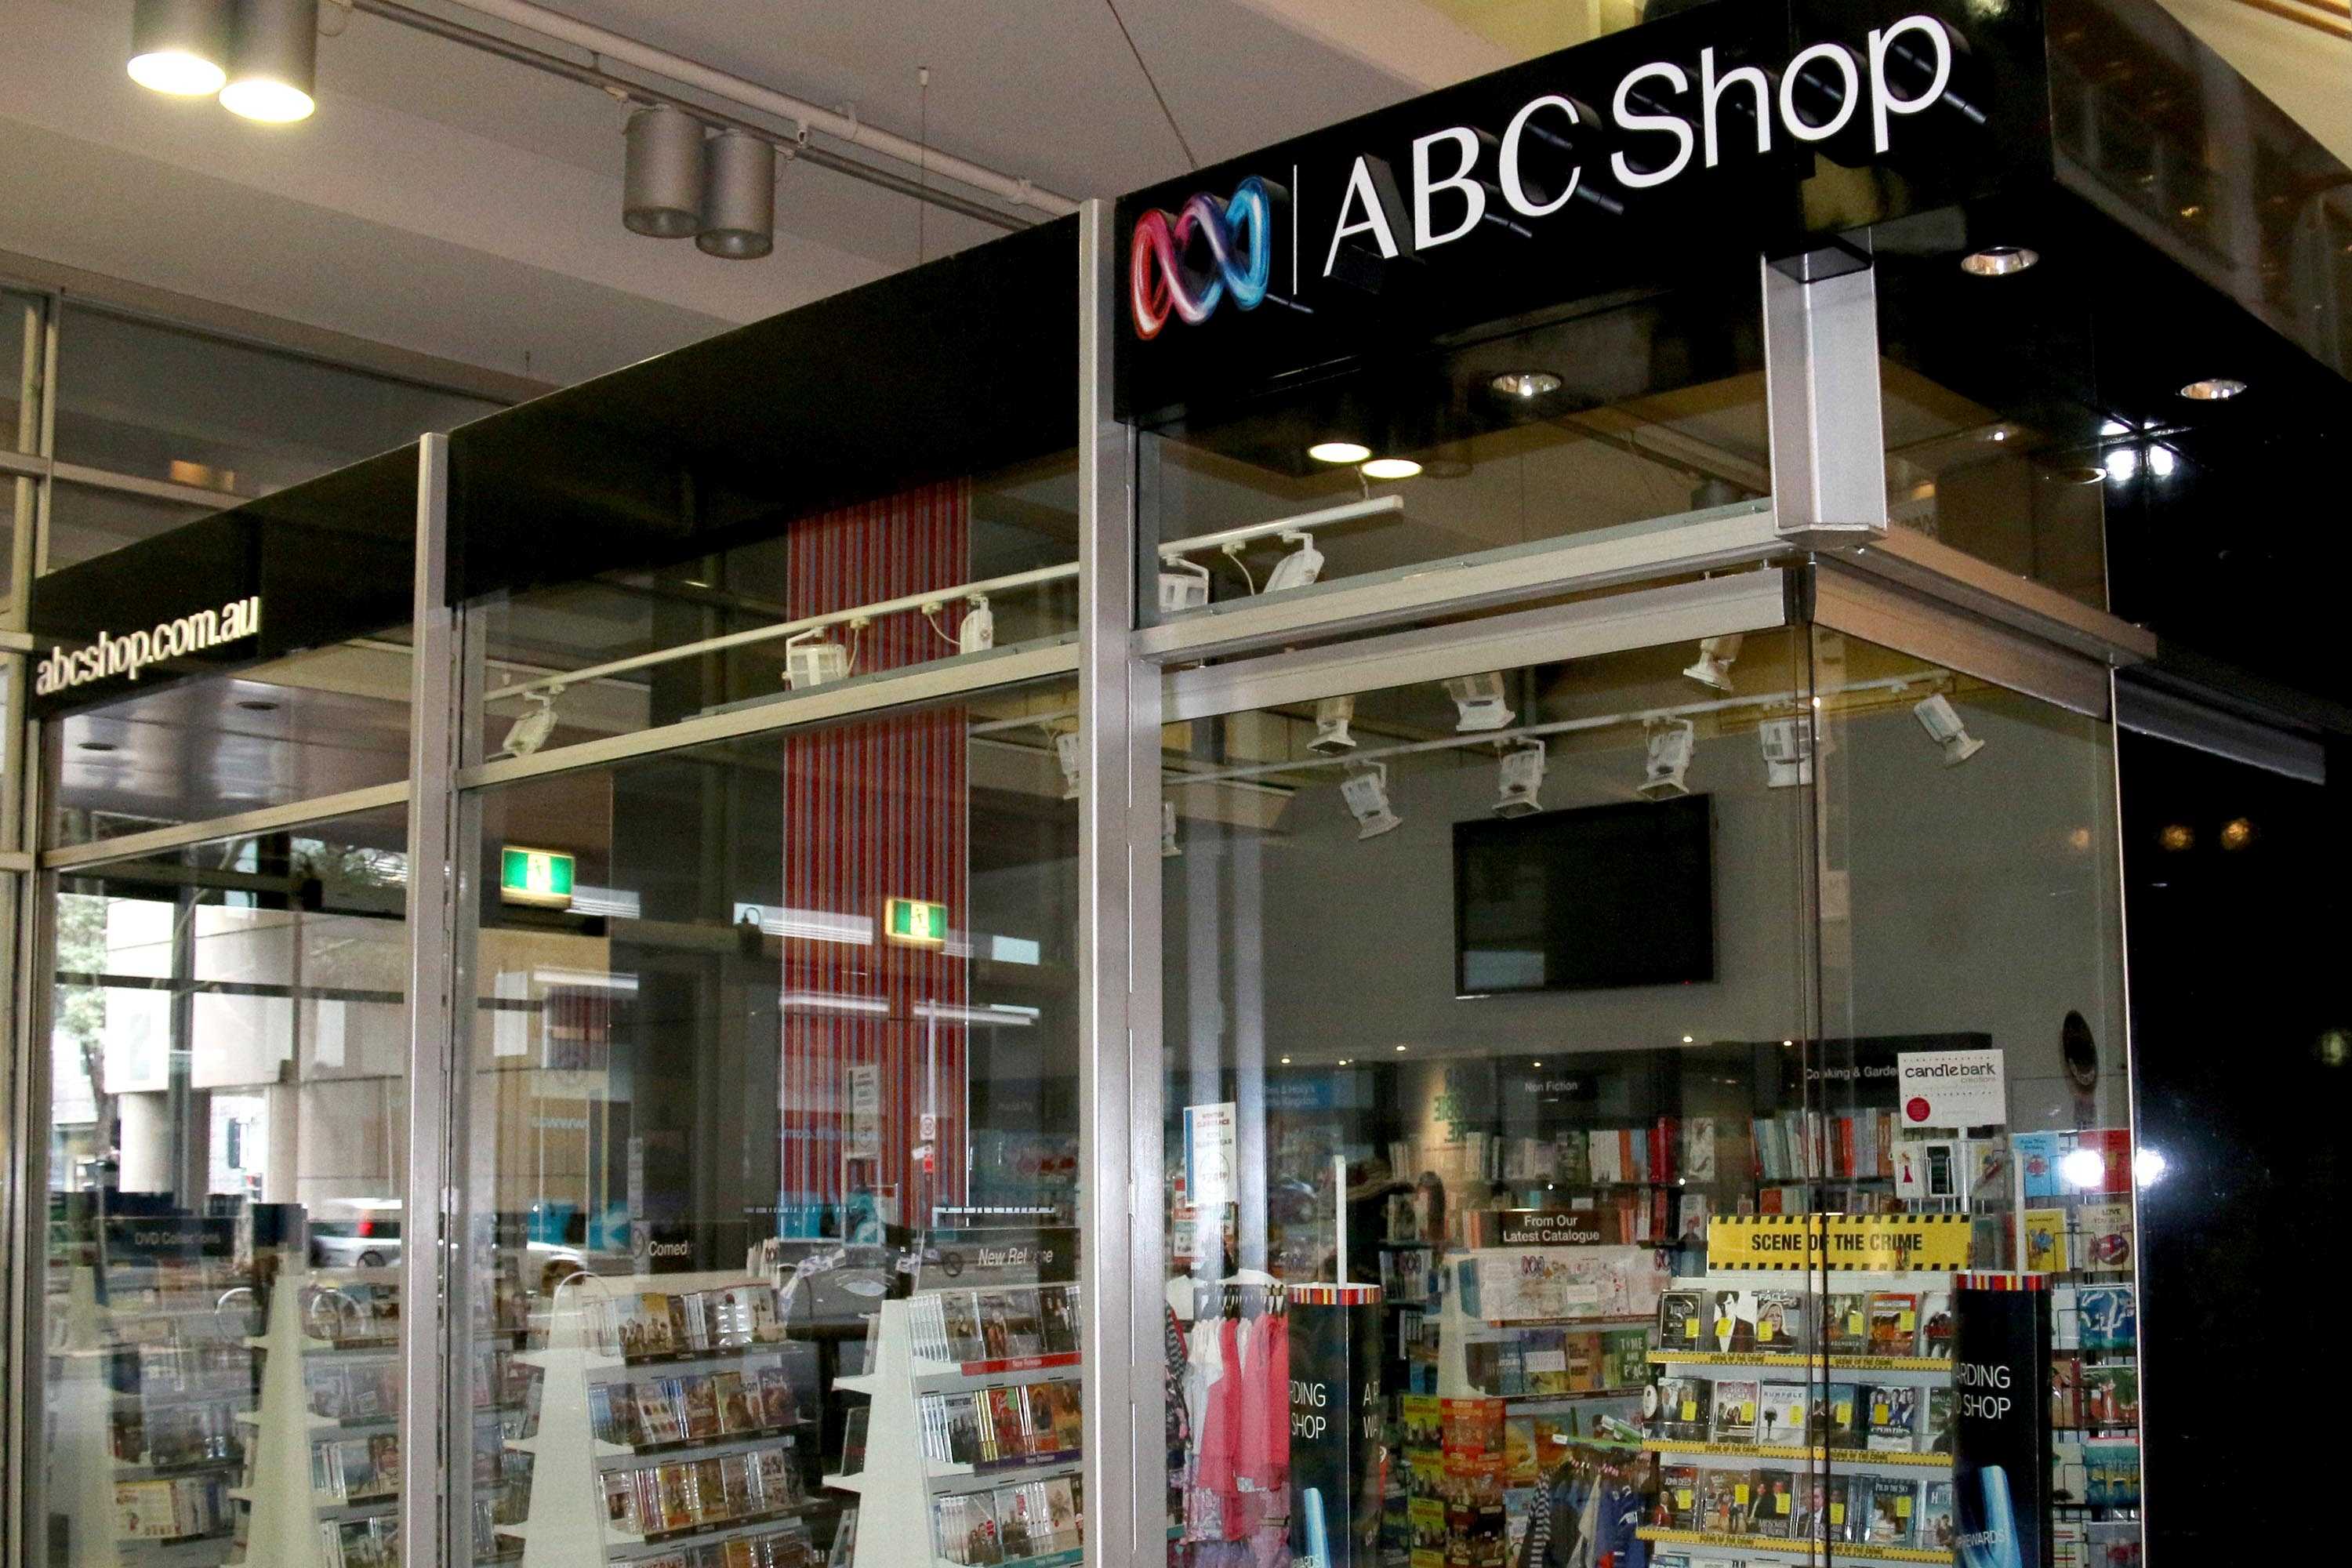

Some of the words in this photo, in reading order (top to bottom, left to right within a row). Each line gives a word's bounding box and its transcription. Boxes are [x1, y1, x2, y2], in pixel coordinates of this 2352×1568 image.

[1323, 96, 1581, 277] ABC
[1611, 16, 1951, 188] Shop
[36, 597, 260, 695] abcshop.com.au
[1905, 1062, 1996, 1078] candlebark
[1524, 1214, 1554, 1227] From
[1556, 1214, 1578, 1226] Our
[1503, 1230, 1540, 1243] Latest
[1541, 1229, 1600, 1243] Catalogue
[1751, 1233, 1802, 1251] SCENE
[1834, 1233, 1864, 1251] THE
[1870, 1233, 1922, 1251] CRIME
[648, 1240, 695, 1258] Comed
[978, 1247, 1005, 1267] New
[1007, 1245, 1053, 1265] Rele
[1963, 1394, 2011, 1419] SHOP
[1291, 1412, 1326, 1439] SHOP
